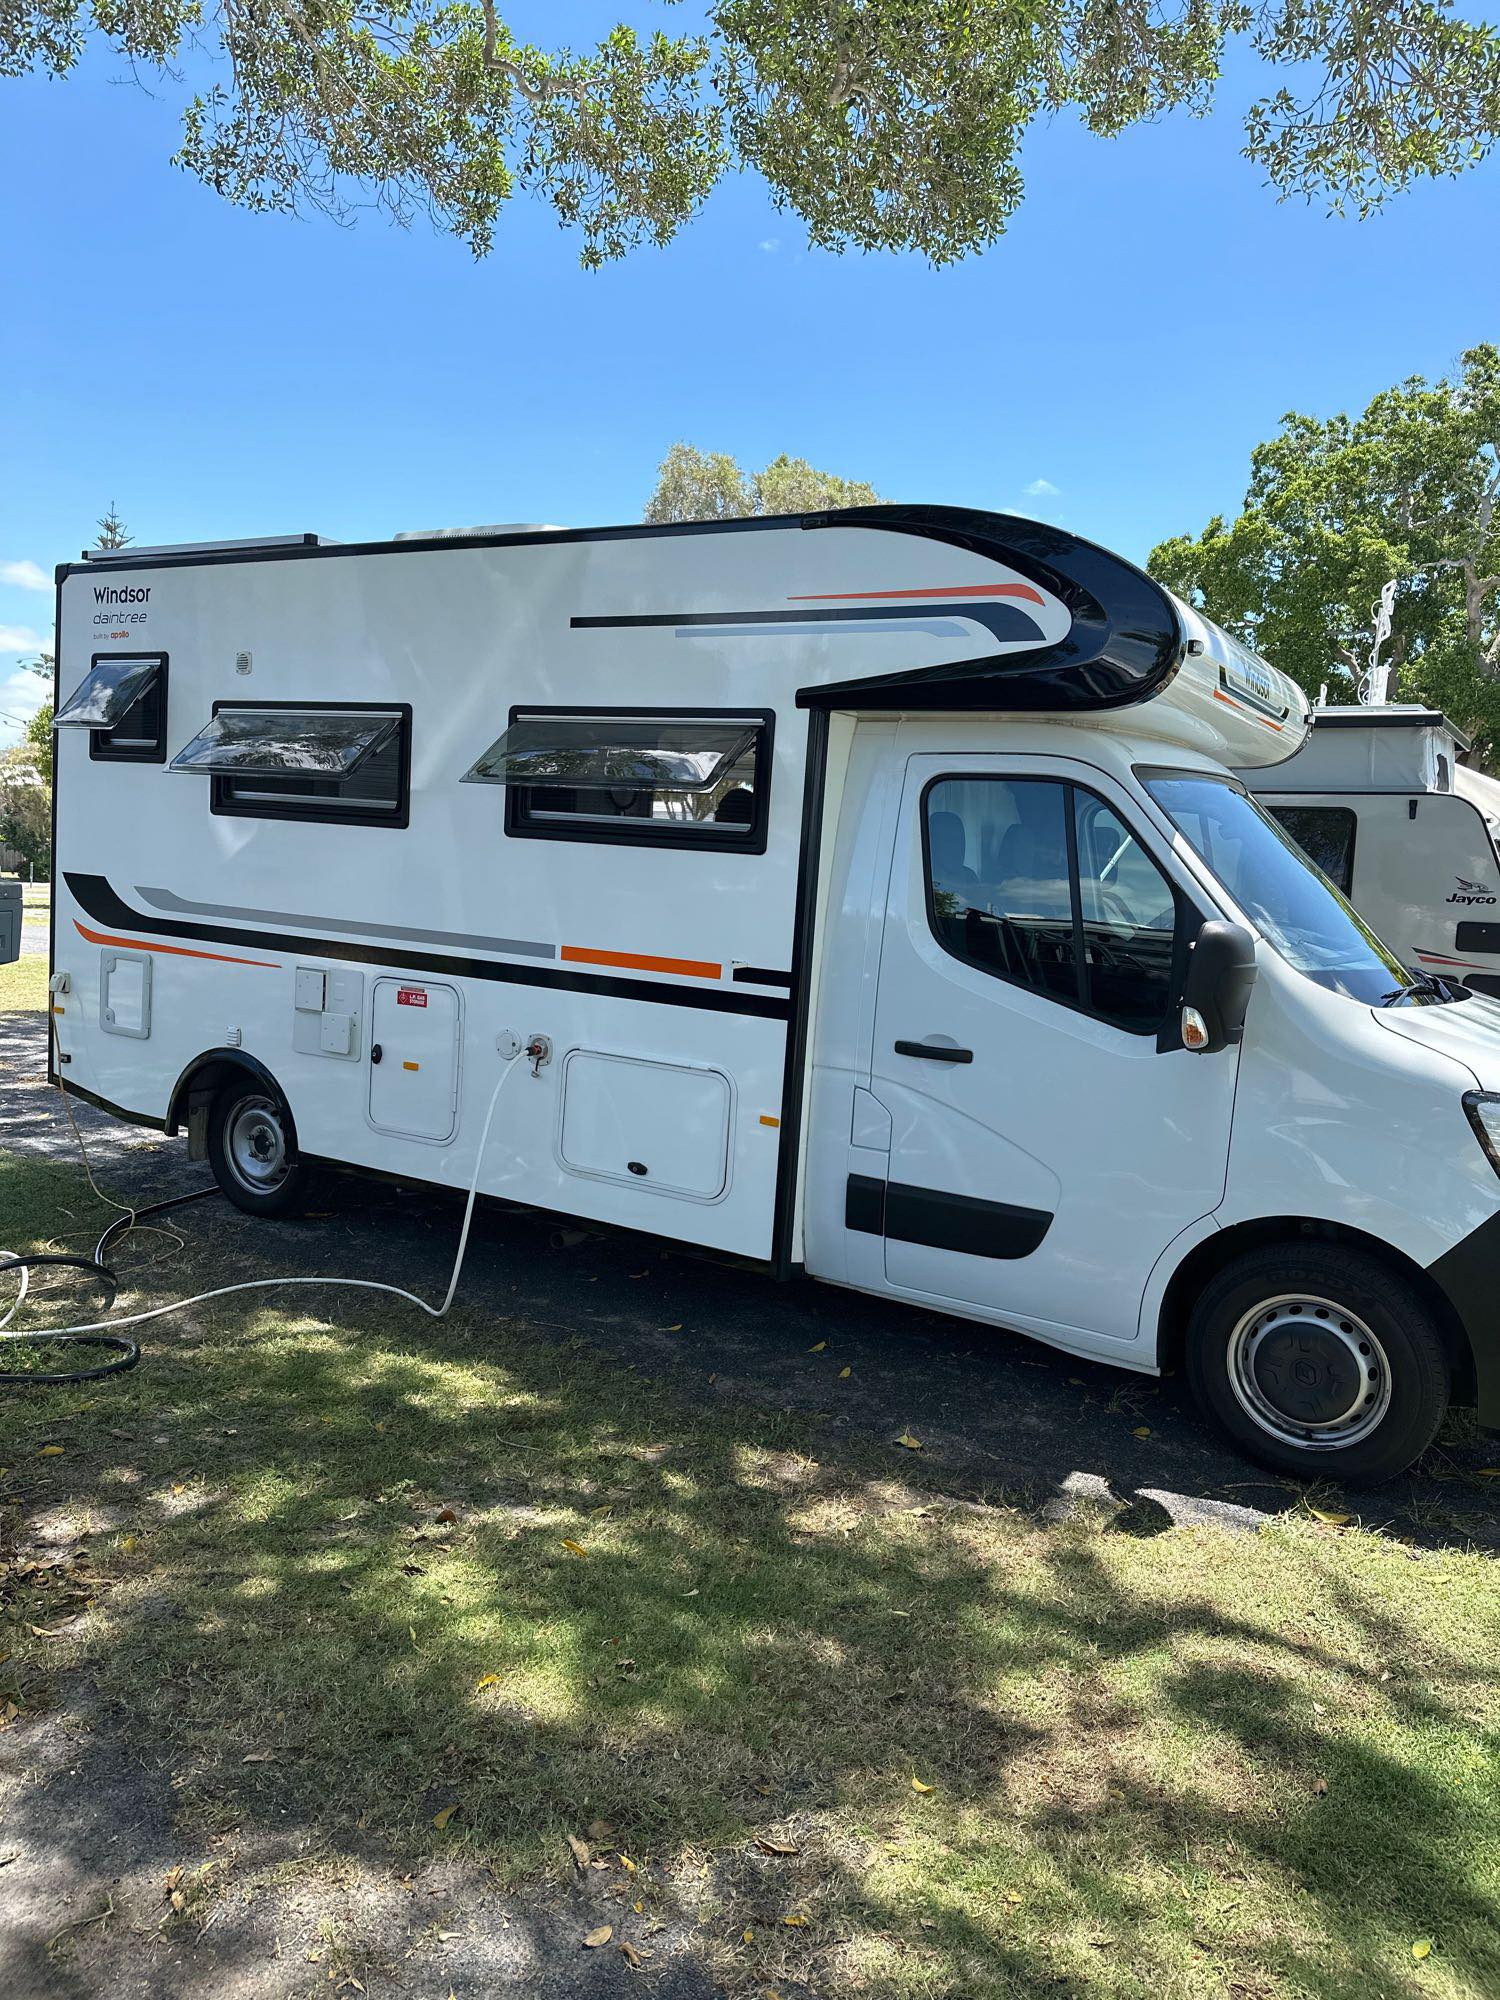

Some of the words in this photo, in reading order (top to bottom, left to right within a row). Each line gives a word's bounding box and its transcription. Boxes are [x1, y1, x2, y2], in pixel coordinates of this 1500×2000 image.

[93, 585, 151, 604] Windsor
[93, 611, 147, 624] daintree
[110, 630, 129, 640] apollo
[1446, 893, 1497, 905] Jayco
